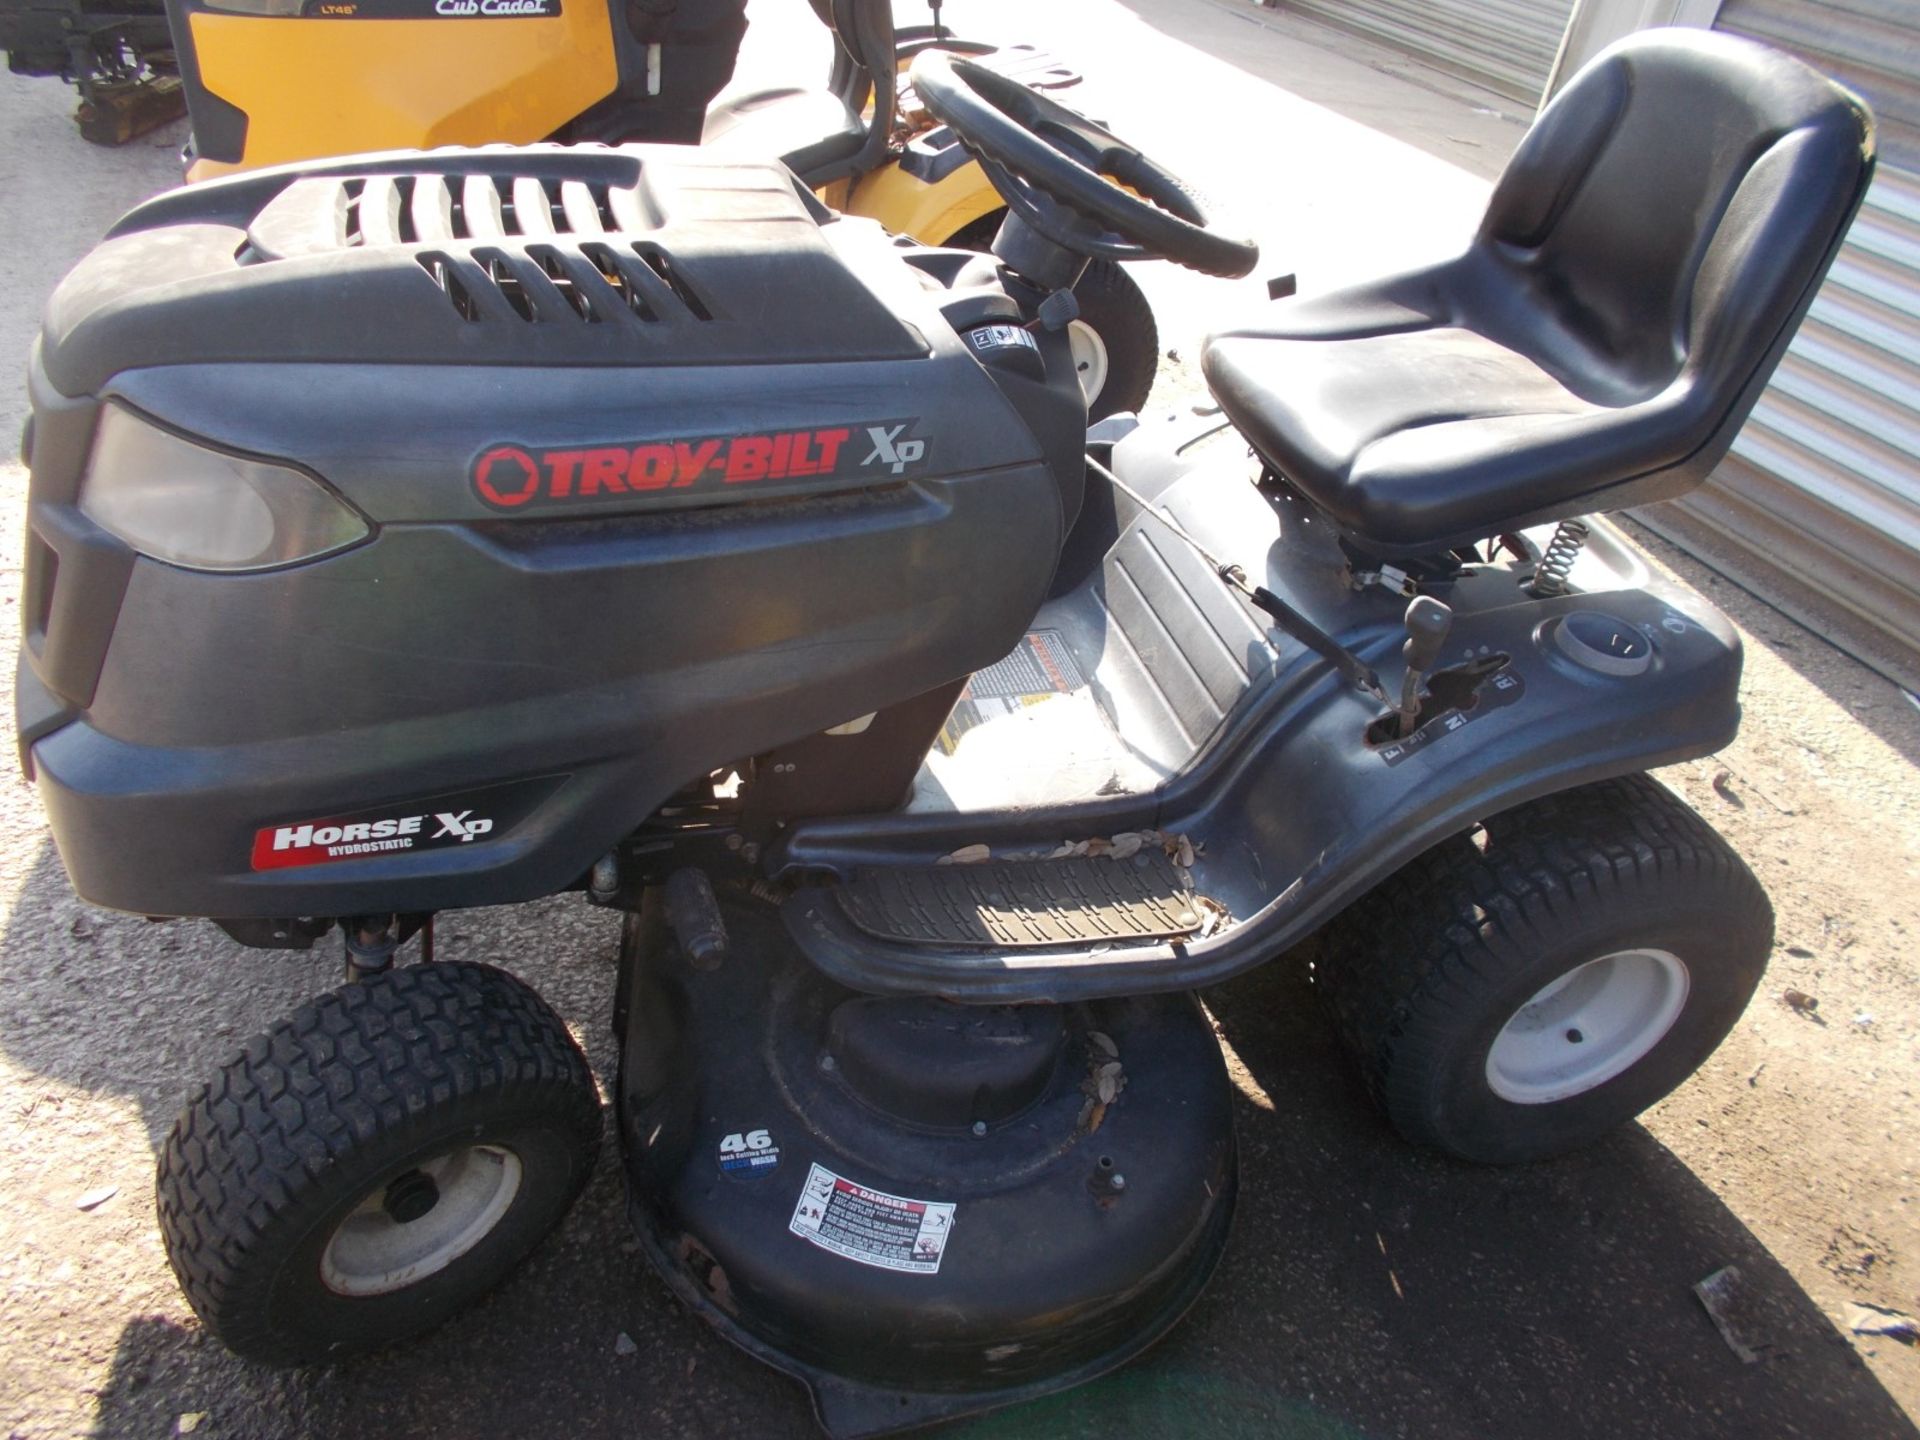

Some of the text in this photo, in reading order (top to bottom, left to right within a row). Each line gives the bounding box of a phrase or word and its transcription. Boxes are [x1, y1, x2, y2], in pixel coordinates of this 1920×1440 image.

[436, 0, 546, 15] Cub Cadet
[543, 429, 849, 497] TROY-BILT
[1496, 673, 1513, 690] R
[1445, 716, 1463, 731] N
[1384, 751, 1400, 761] F
[273, 816, 423, 850] HORSE
[328, 838, 413, 857] HYDROSTATIC
[720, 1129, 772, 1152] 46
[859, 1190, 909, 1209] DANGER
